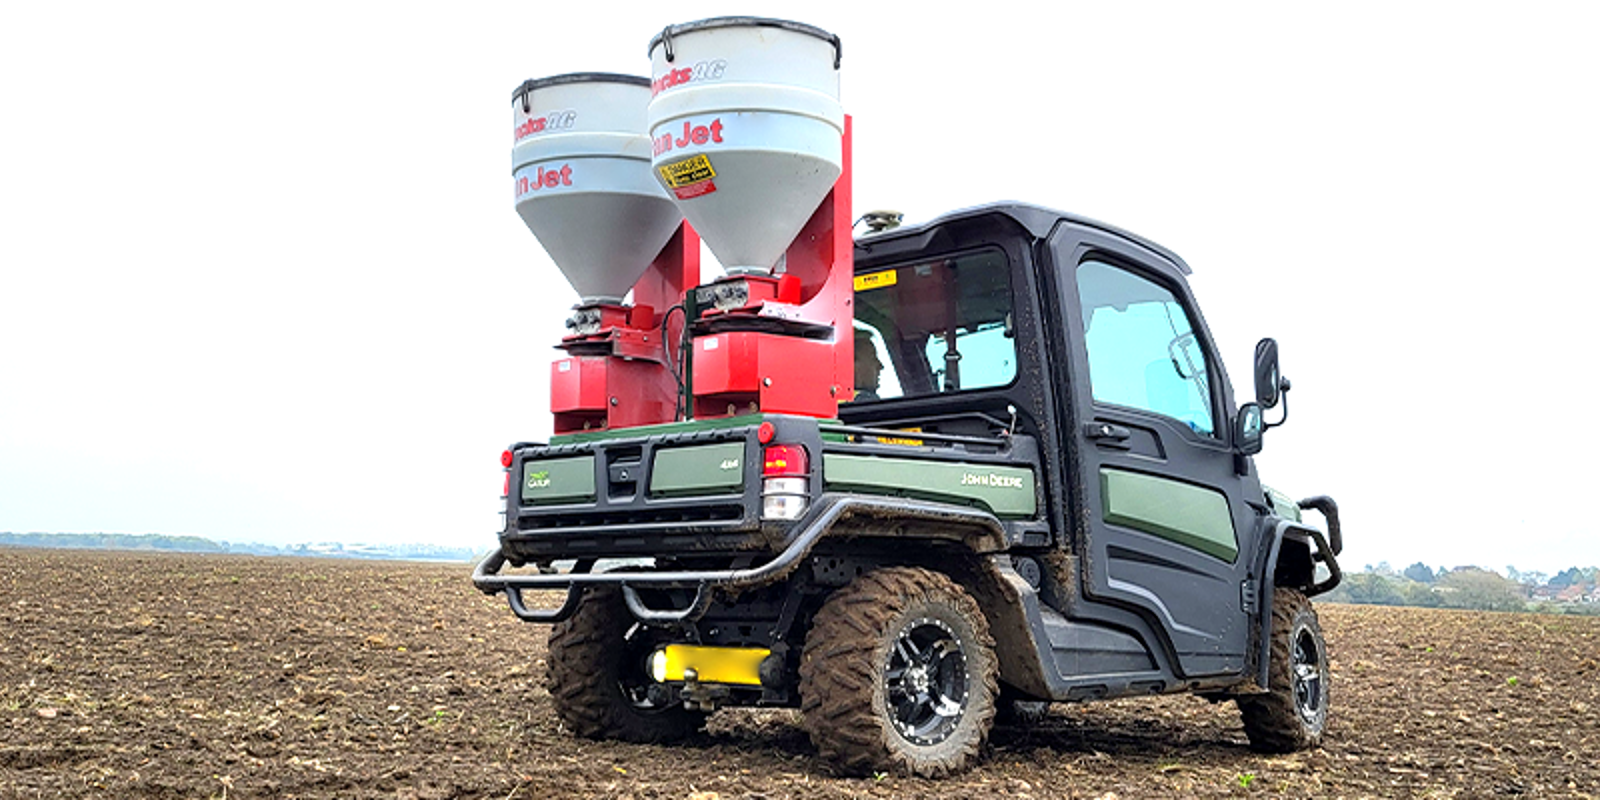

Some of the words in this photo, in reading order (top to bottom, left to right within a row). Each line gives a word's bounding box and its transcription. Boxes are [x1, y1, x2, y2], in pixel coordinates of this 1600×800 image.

[675, 118, 724, 148] Jet
[530, 164, 573, 190] Jet
[960, 473, 988, 485] JOHN
[988, 473, 1023, 488] DEERE
